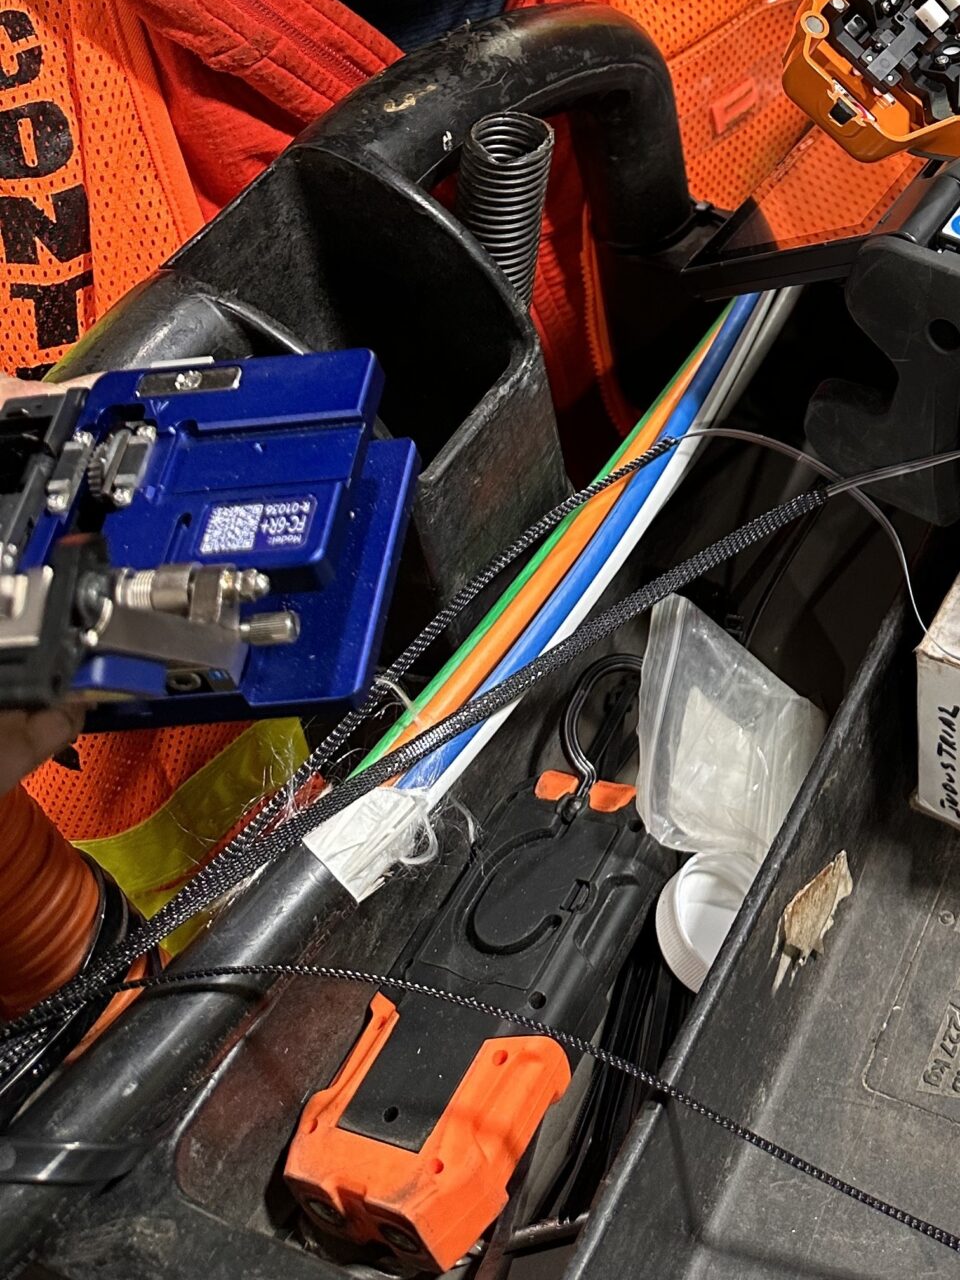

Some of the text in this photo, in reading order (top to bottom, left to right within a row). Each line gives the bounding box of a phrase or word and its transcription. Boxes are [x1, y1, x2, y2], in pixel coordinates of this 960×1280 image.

[0, 8, 93, 381] CONT
[264, 501, 311, 516] R-01036
[260, 514, 307, 535] FC-6R+
[922, 1058, 952, 1088] kg
